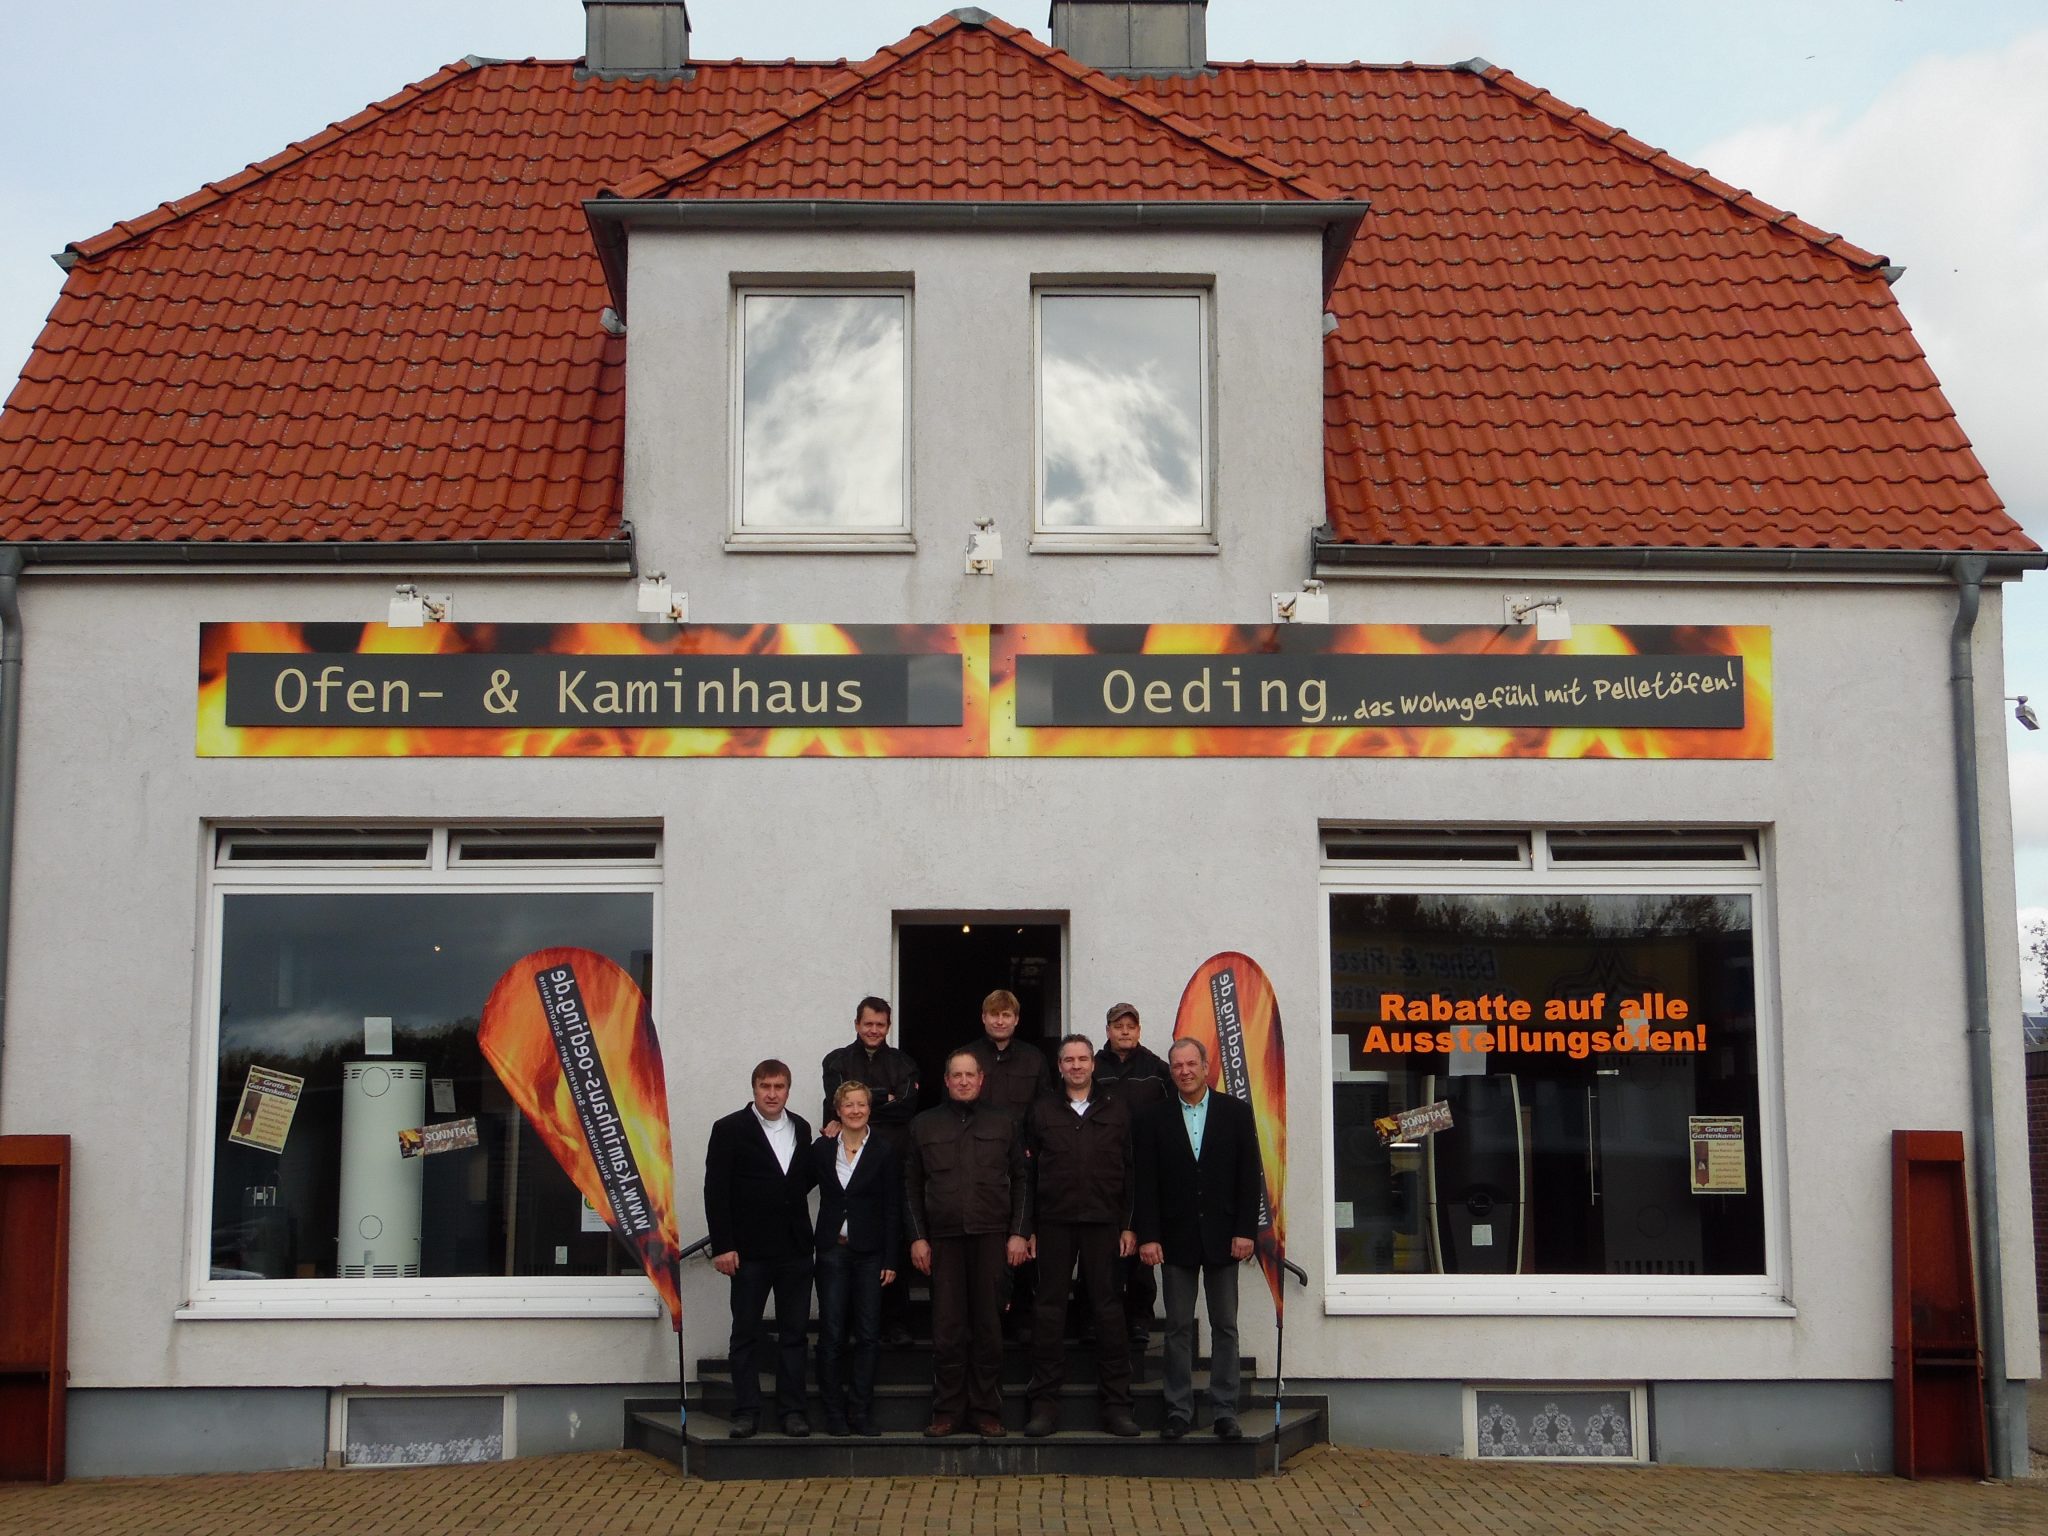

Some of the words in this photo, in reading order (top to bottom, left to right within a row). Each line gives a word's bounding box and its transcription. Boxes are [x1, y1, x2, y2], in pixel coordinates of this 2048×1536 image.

[274, 665, 444, 714] Ofen-
[483, 669, 519, 714] &
[558, 667, 863, 714] Kaminhaus
[1102, 666, 1327, 723] Oeding
[1353, 699, 1396, 720] das
[1400, 685, 1539, 722] Wohngefühl
[1544, 677, 1588, 706] mit
[1592, 660, 1738, 701] Pelletöfen!
[1380, 994, 1532, 1021] Rabatte
[1545, 992, 1606, 1021] auf
[1619, 992, 1689, 1021] alle
[1363, 1024, 1708, 1059] Ausstellungsöfen!
[248, 1082, 297, 1099] Gartenkamin
[263, 1079, 286, 1090] Gratis
[1401, 1107, 1450, 1129] SONNTAG
[425, 1124, 476, 1142] SONNTAG
[1692, 1132, 1742, 1140] Gartenkamin
